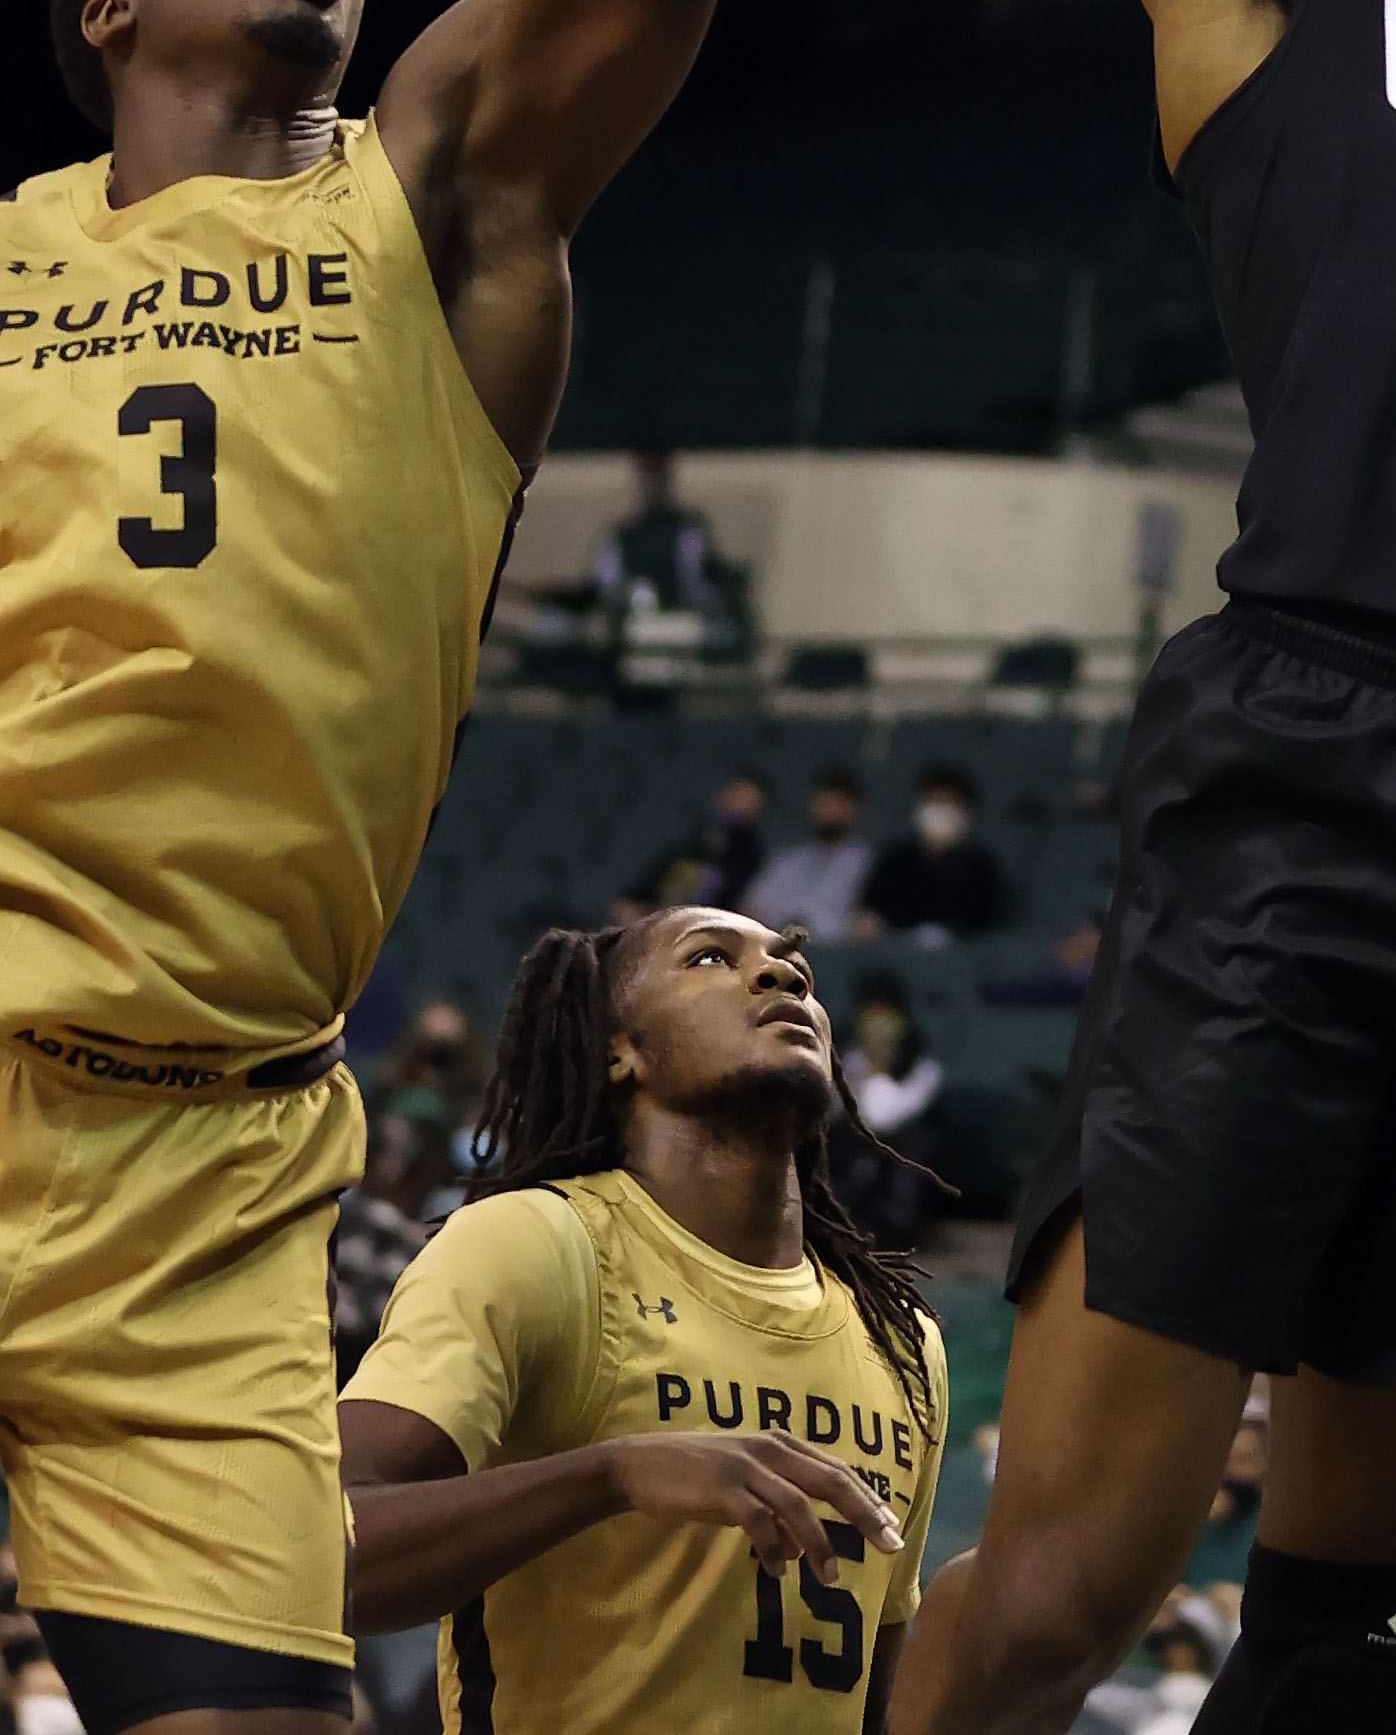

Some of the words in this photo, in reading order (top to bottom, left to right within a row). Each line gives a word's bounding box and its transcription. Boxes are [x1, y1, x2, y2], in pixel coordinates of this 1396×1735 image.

[0, 252, 352, 339] PURDUE
[32, 330, 146, 370] FORT
[153, 322, 301, 359] WAYNE
[117, 382, 217, 568] 3
[656, 1372, 914, 1473] PURDUE
[743, 1517, 865, 1694] 15
